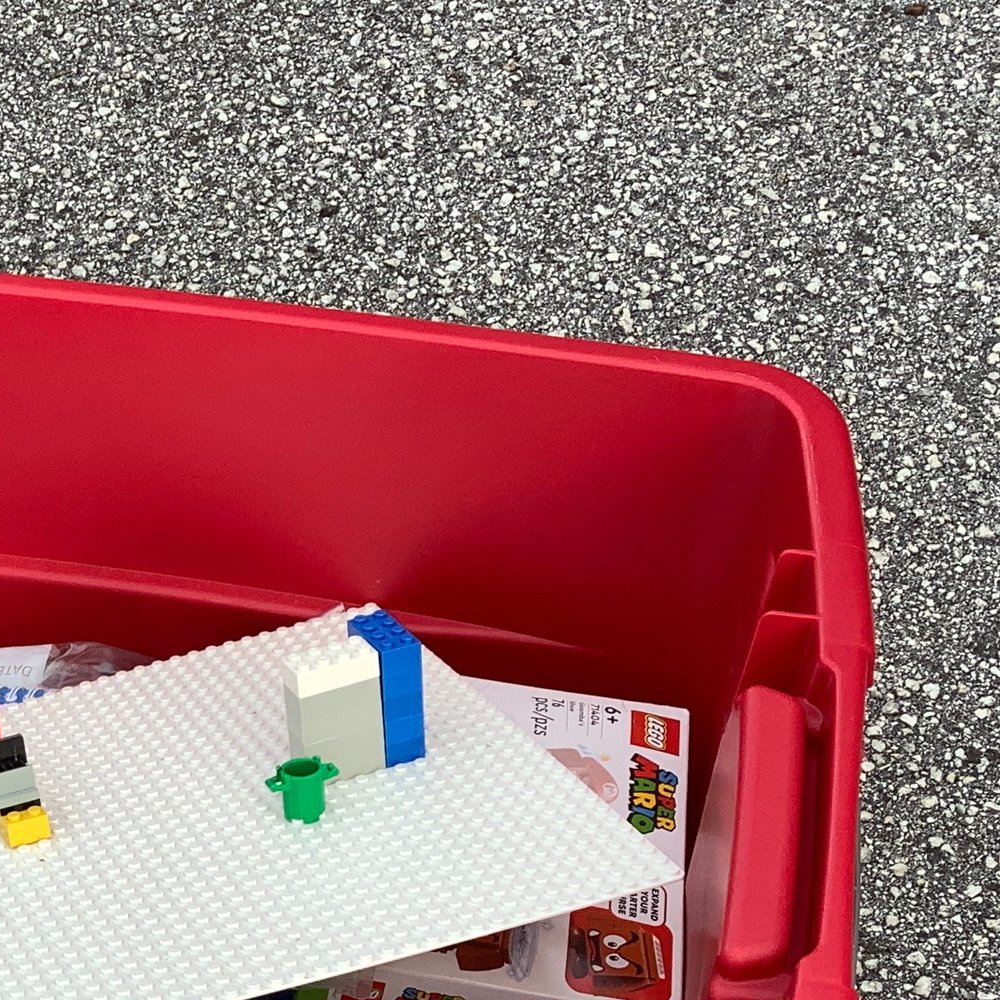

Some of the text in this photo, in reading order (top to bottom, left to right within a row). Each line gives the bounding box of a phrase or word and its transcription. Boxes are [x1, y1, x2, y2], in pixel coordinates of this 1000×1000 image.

[531, 696, 552, 737] pcs/pzs
[550, 698, 564, 708] 76
[590, 703, 599, 726] 71404
[604, 706, 620, 724] 6+
[645, 714, 668, 750] LEGO
[627, 752, 659, 836] MARIO
[655, 769, 679, 834] SUPER
[618, 896, 626, 914] RSE
[639, 890, 649, 914] YOUR
[650, 888, 659, 921] EXPAND
